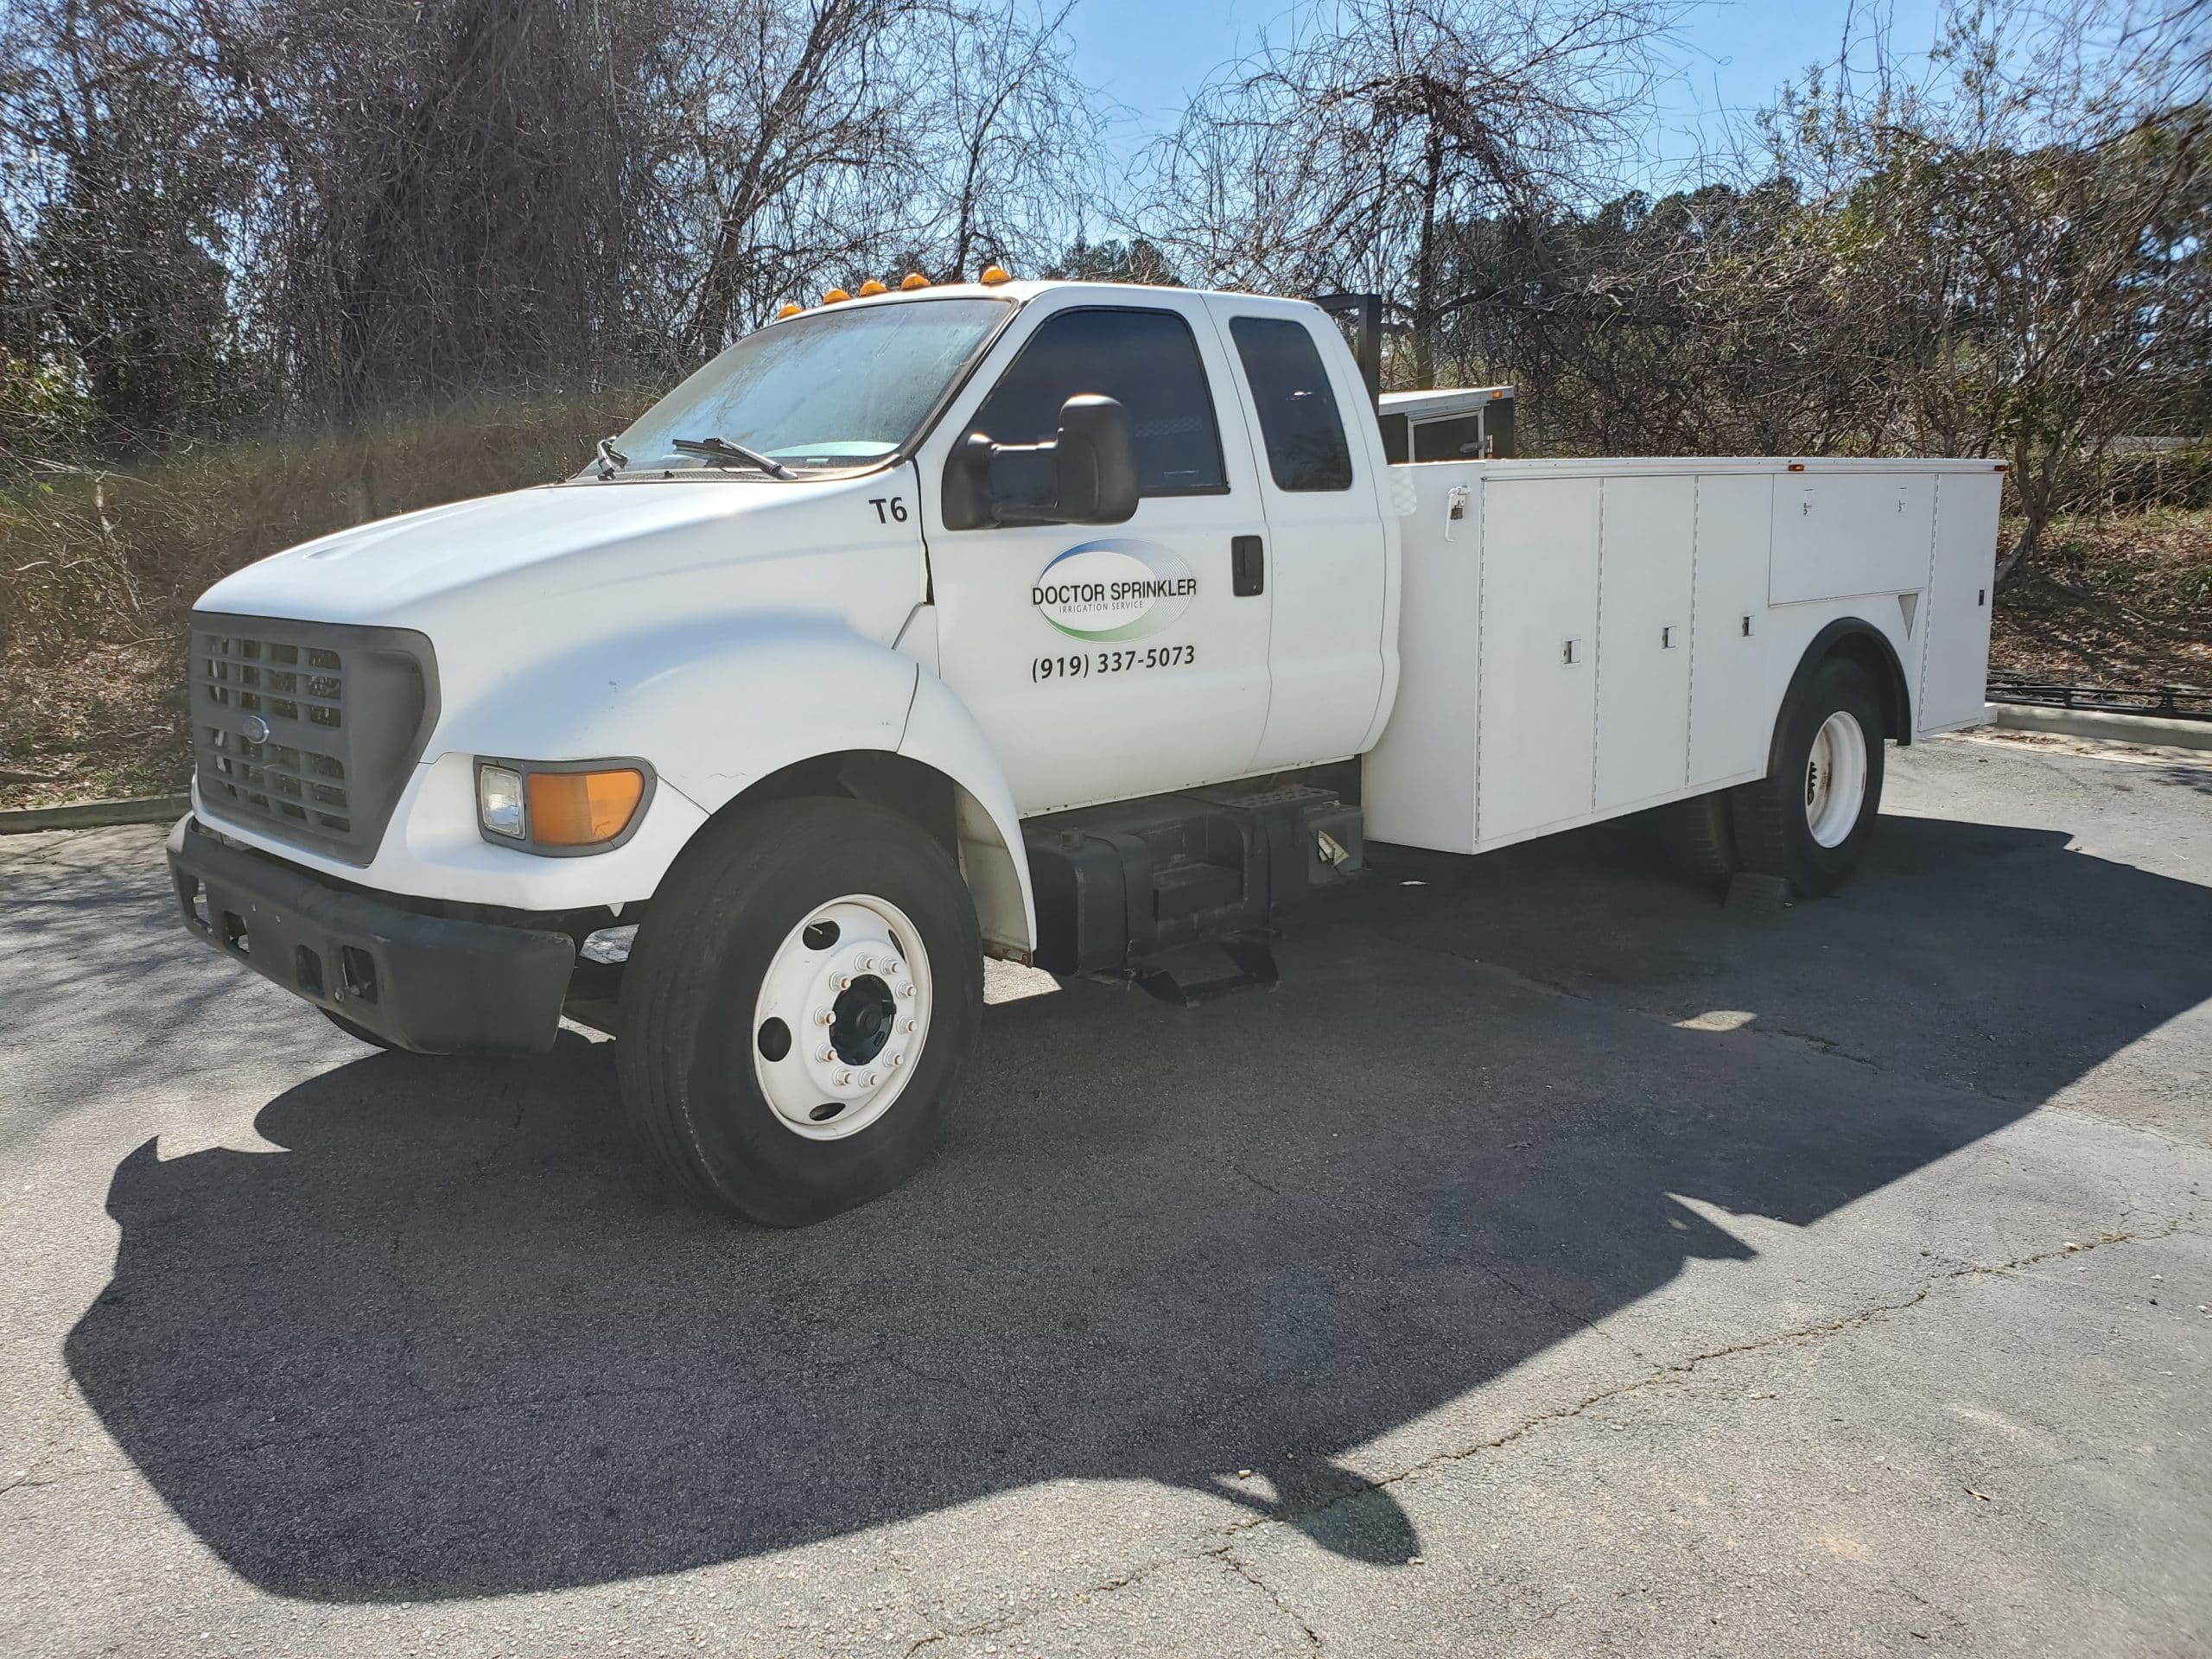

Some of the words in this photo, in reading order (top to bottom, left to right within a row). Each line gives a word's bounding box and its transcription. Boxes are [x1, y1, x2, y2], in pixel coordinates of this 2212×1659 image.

[868, 497, 907, 524] T6
[1032, 584, 1105, 605] DOCTOR
[1110, 578, 1197, 600] SPRINKLER
[1059, 603, 1109, 613] IRRIGATION
[1111, 601, 1143, 610] SERVICE
[1032, 654, 1090, 683] (919)
[1097, 645, 1195, 673] 337-5073
